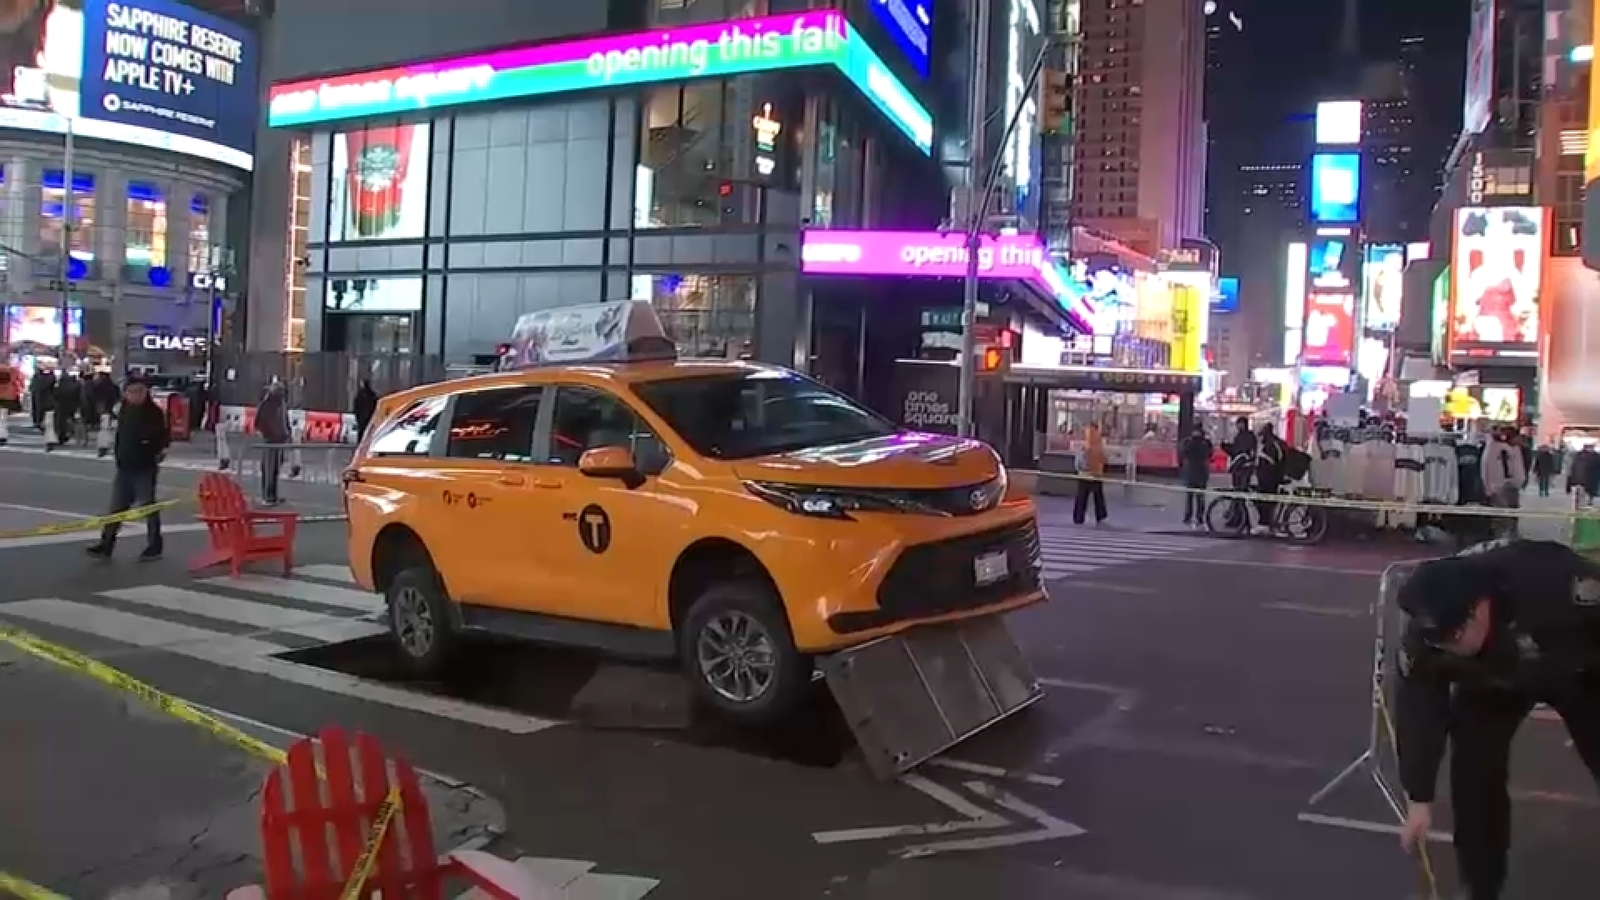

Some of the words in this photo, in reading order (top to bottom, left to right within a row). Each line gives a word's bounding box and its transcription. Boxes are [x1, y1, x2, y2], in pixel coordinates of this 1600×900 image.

[107, 3, 189, 44] SAPPHIRE
[191, 25, 242, 64] RESERVE
[586, 34, 709, 79] opening
[718, 23, 781, 61] this
[106, 29, 148, 60] NOW
[151, 40, 203, 74] COMES
[205, 55, 234, 85] WITH
[104, 58, 159, 91] APPLE
[163, 69, 195, 95] TV+
[1471, 152, 1483, 204] 1500
[901, 246, 993, 271] openig
[904, 399, 949, 413] times
[908, 391, 938, 402] one
[585, 514, 604, 548] T
